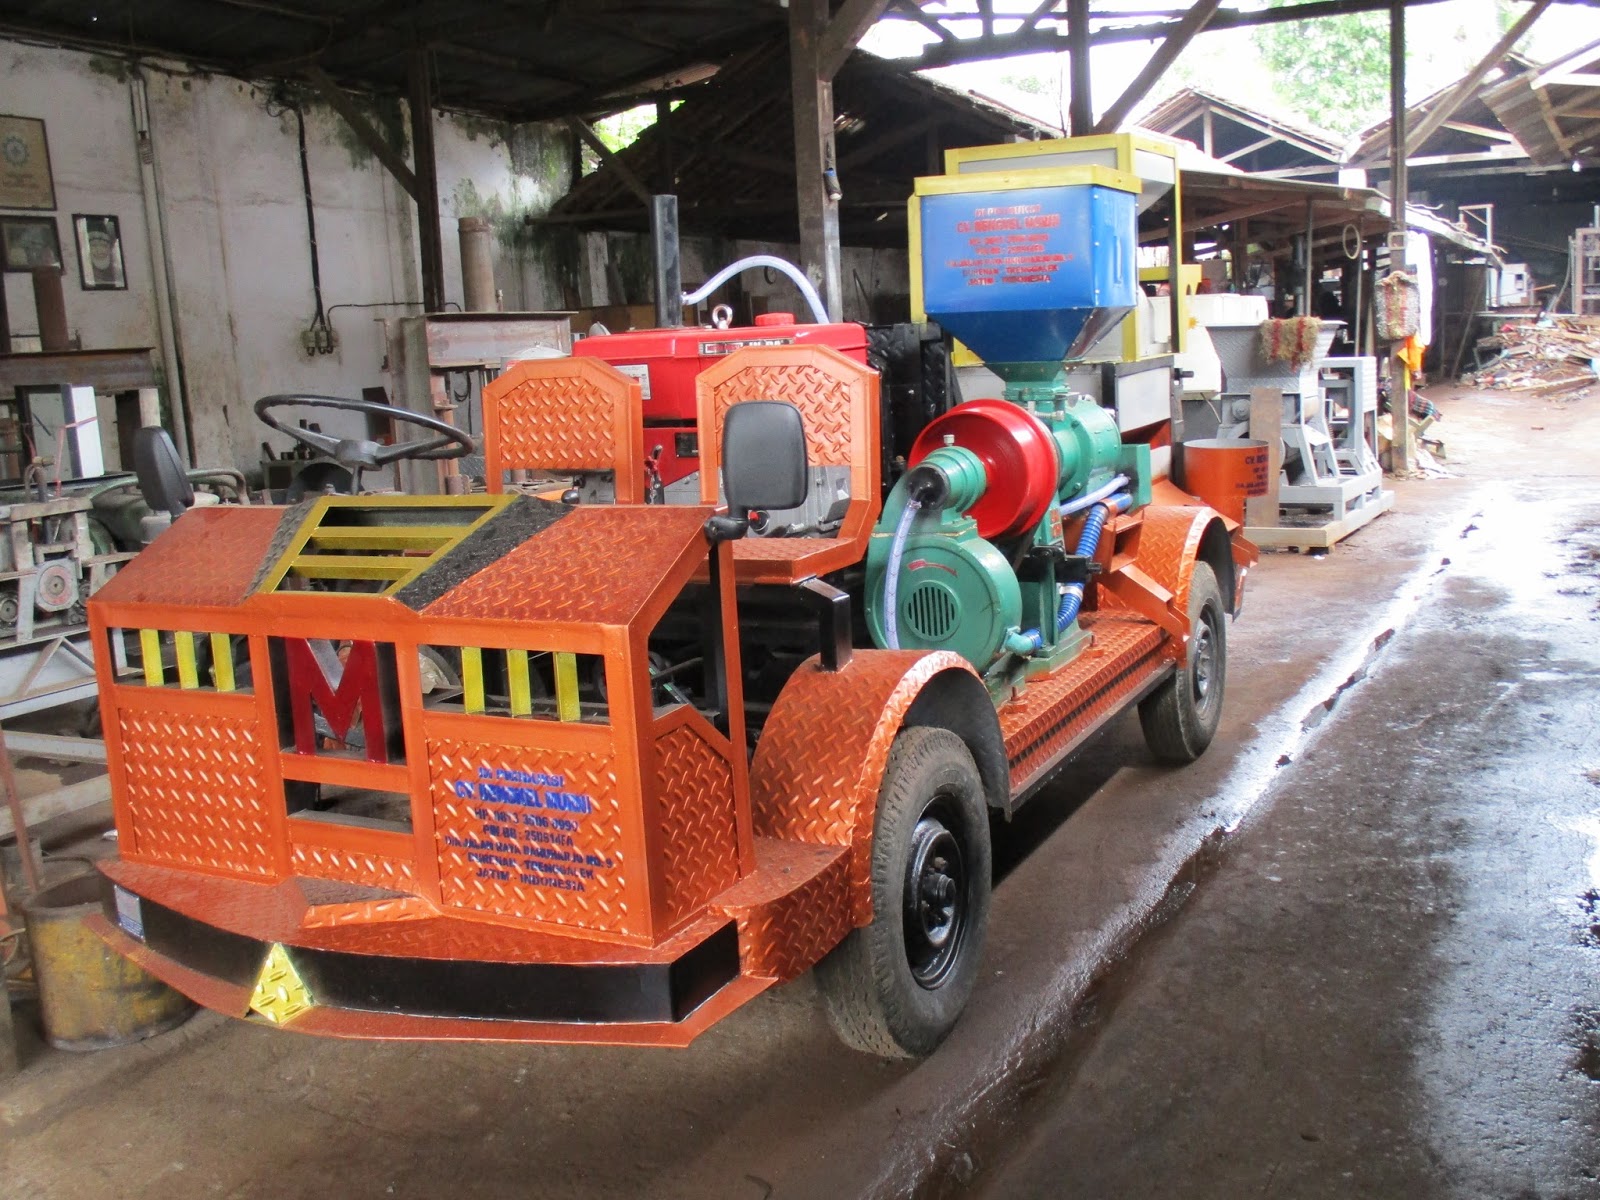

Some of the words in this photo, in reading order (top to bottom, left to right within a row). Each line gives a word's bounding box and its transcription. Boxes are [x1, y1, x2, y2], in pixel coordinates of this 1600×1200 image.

[286, 637, 387, 764] M
[496, 769, 565, 787] PRODUKSI
[476, 868, 510, 881] JATIM
[520, 874, 585, 892] INDONESIA
